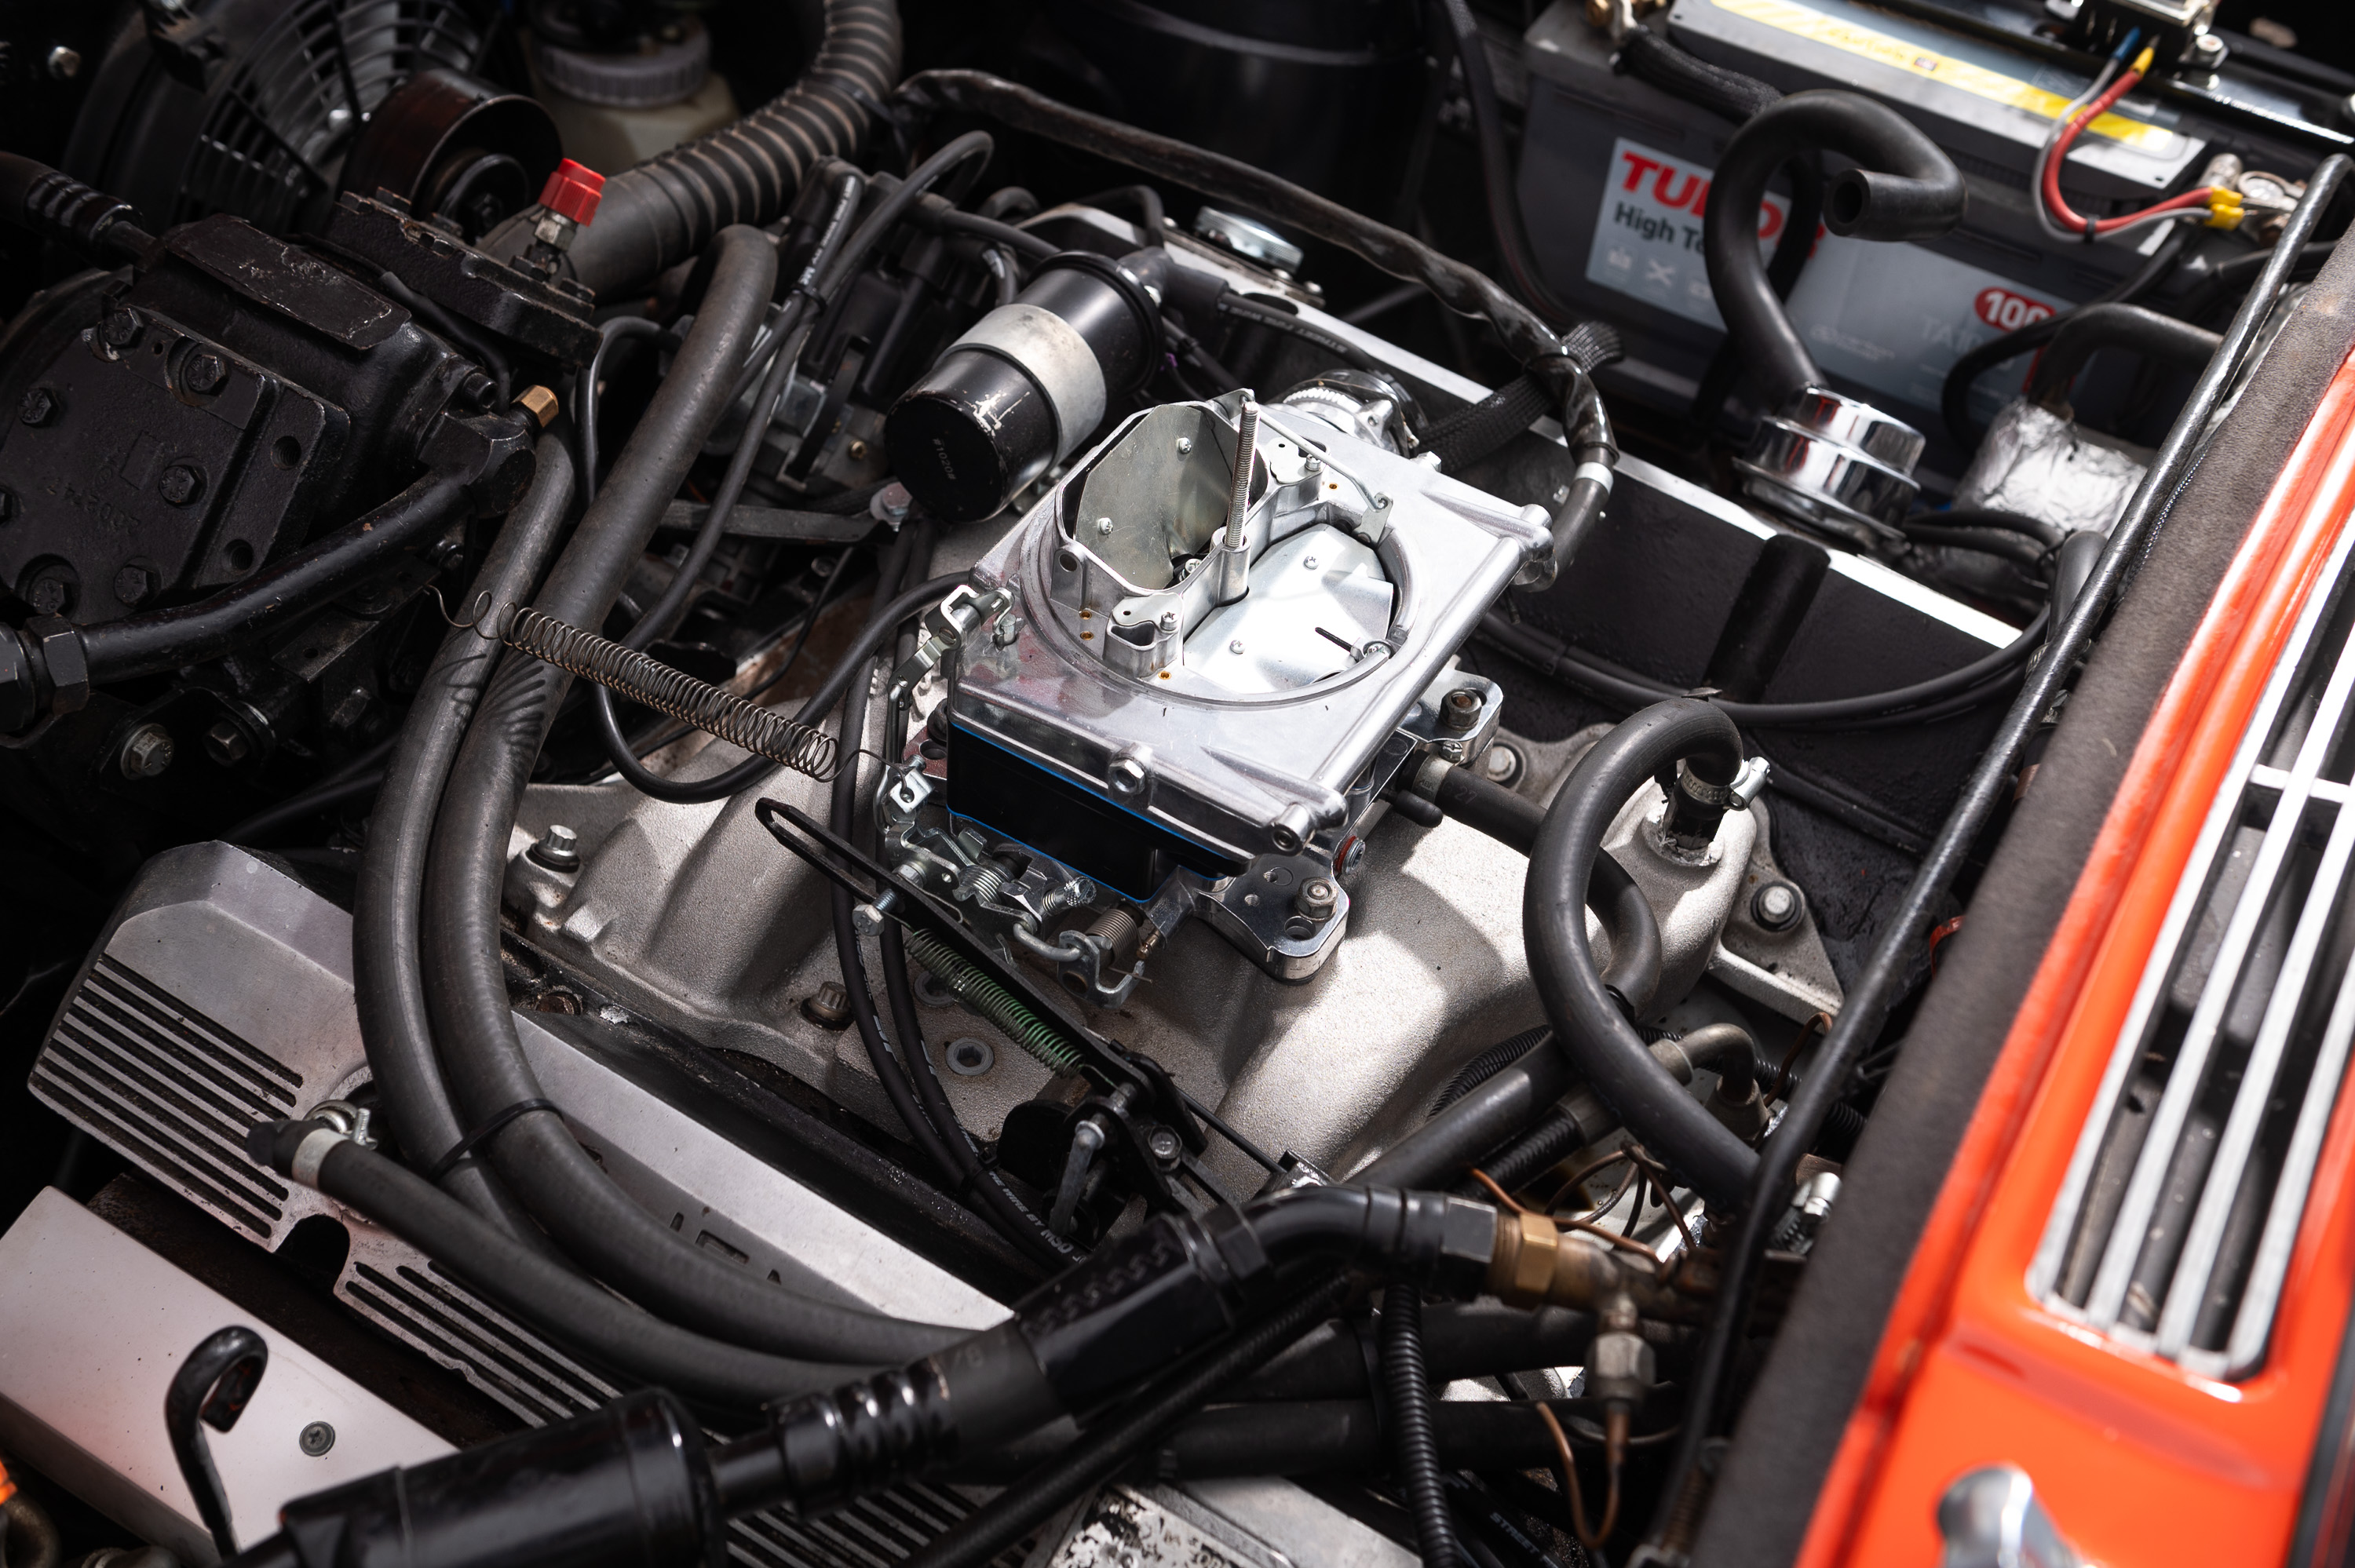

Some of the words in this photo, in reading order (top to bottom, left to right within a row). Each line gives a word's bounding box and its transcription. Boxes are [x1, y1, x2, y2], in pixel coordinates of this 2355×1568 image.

[1615, 202, 1675, 245] High
[1002, 1187, 1030, 1212] WIRE
[1025, 1212, 1046, 1227] BY
[1040, 1228, 1075, 1254] MSD
[1489, 1511, 1540, 1554] STREET
